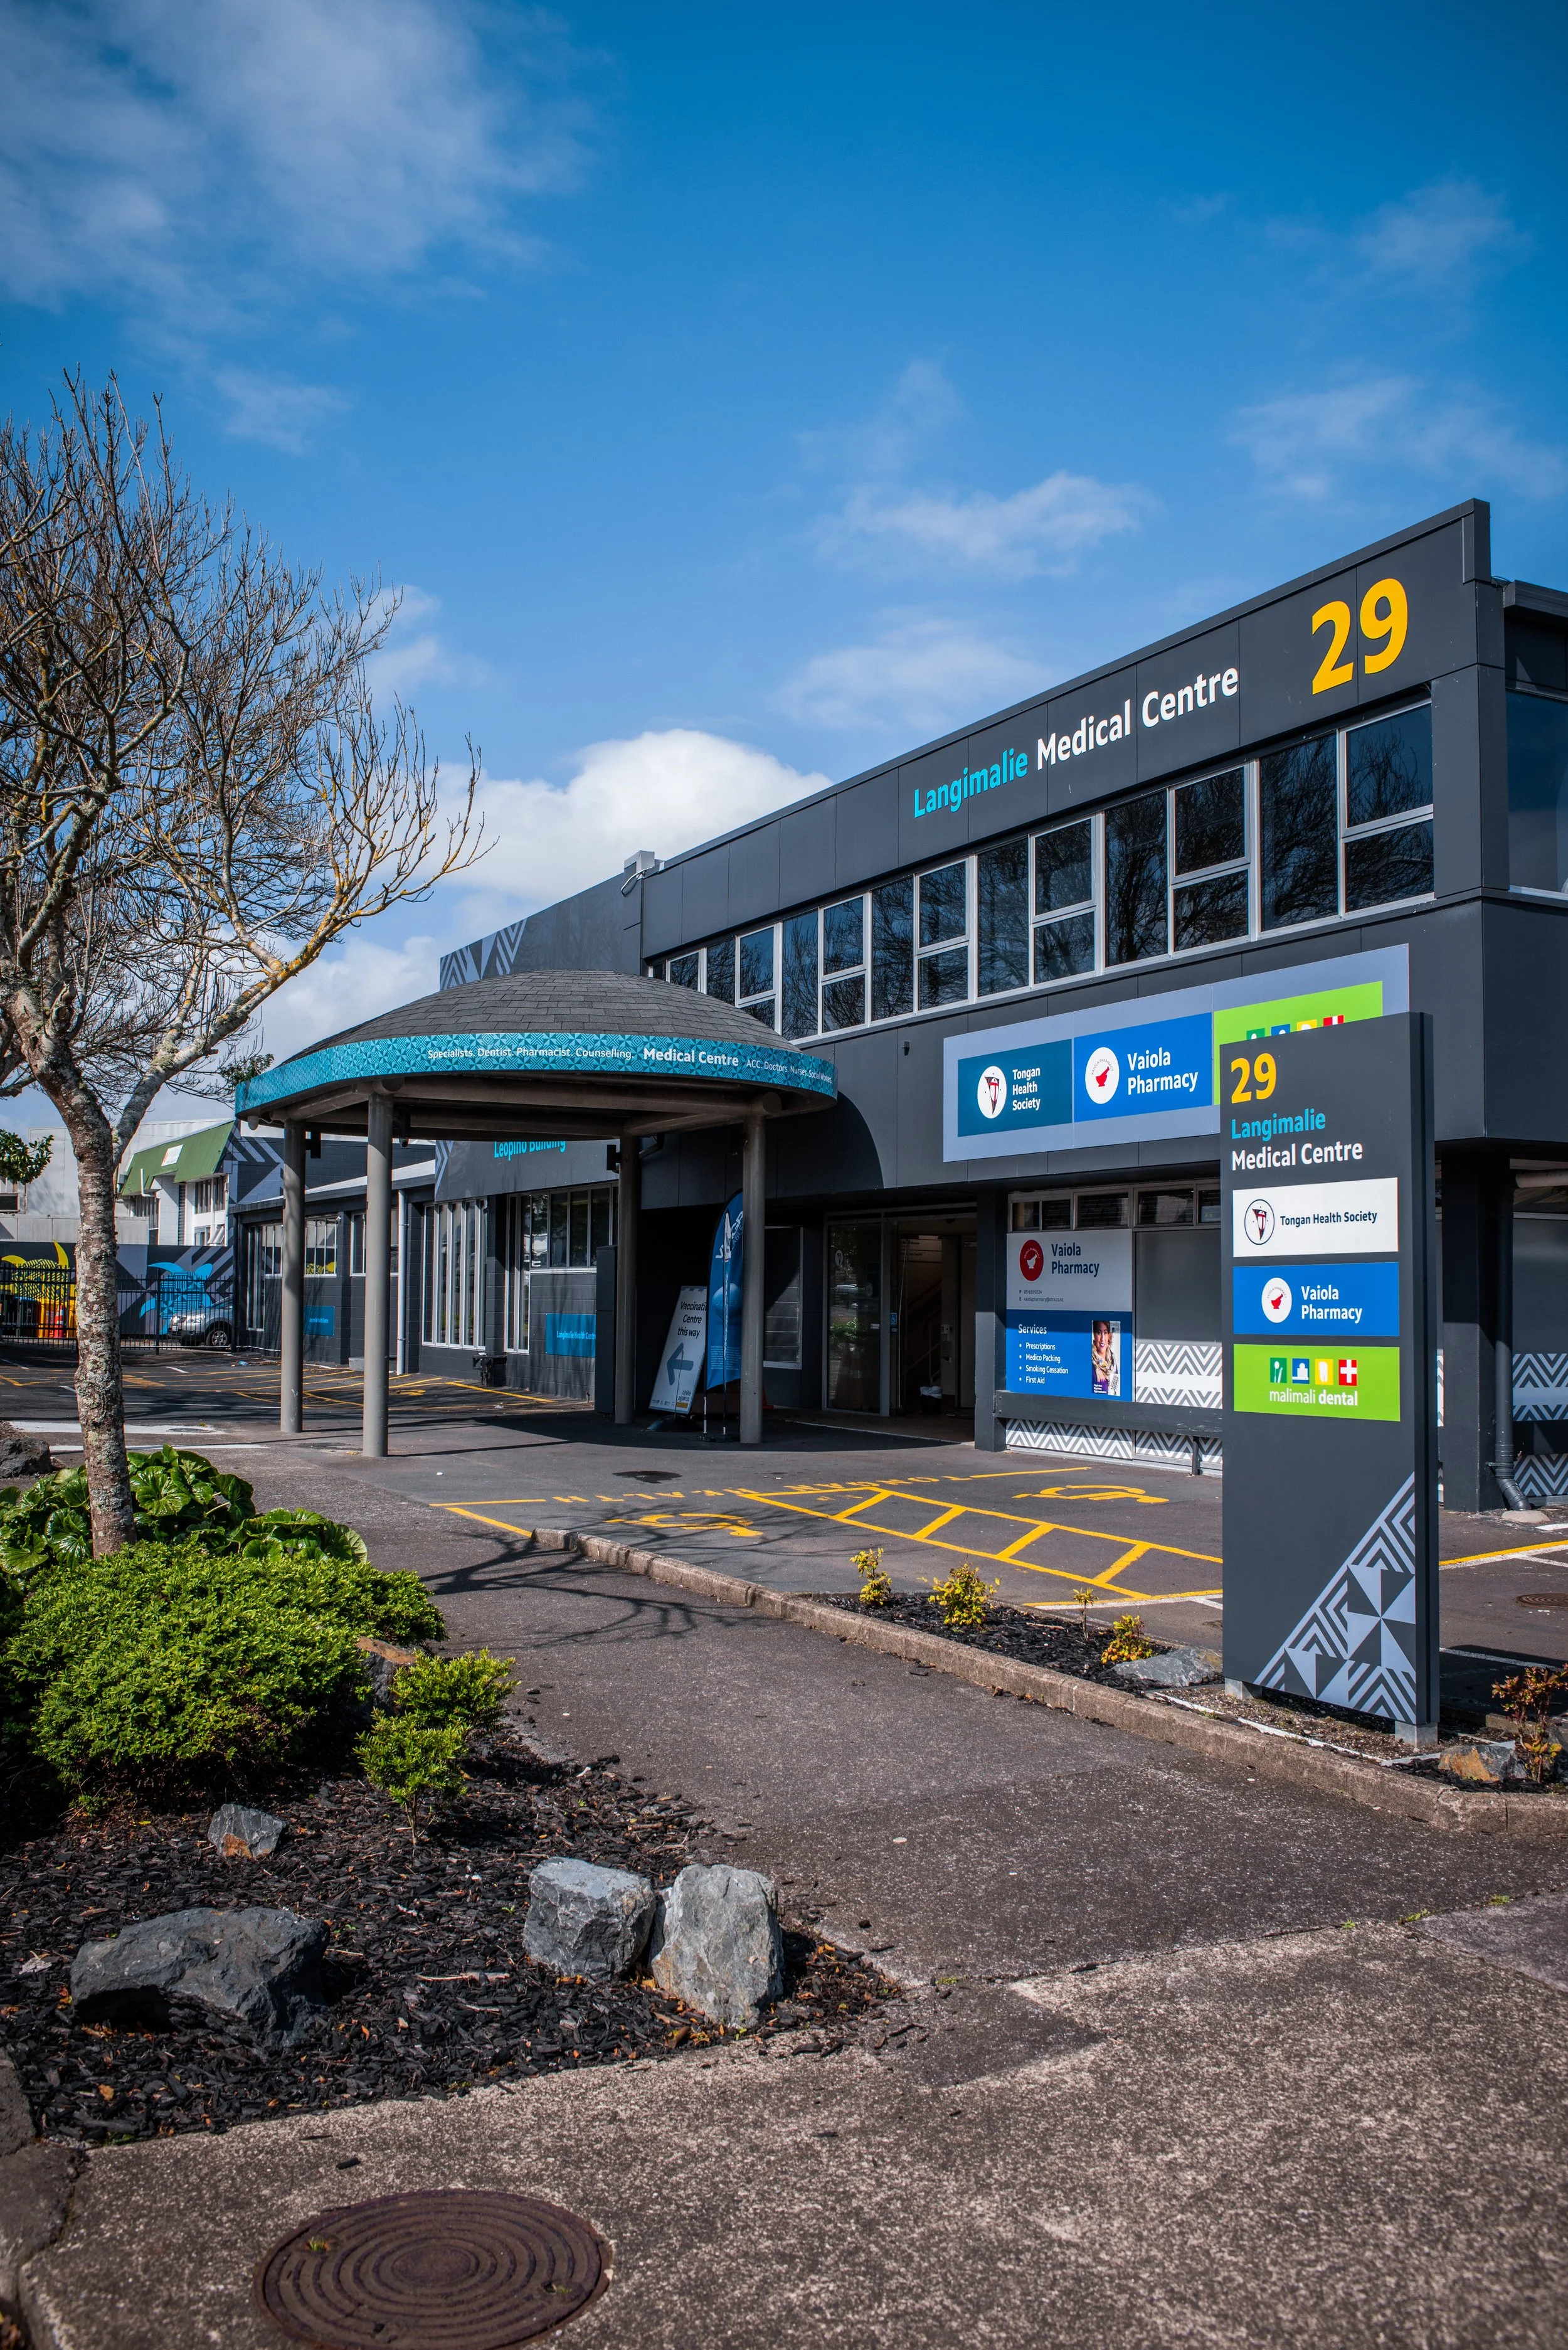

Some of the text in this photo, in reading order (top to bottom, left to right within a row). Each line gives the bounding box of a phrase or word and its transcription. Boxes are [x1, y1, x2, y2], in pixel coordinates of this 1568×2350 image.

[1311, 578, 1409, 695] 29
[914, 667, 1239, 819] Langimalie Medical Centre
[428, 1048, 634, 1060] Specialists. Dentist. Pharmacist. Counselling.
[644, 1048, 739, 1066] Medical Centre
[1127, 1047, 1171, 1071] Vaiola
[764, 1061, 789, 1073] Doctors.
[1012, 1066, 1041, 1082] Tongan
[1128, 1069, 1199, 1096] Pharmacy
[1231, 1053, 1277, 1104] 29
[1012, 1081, 1038, 1095] Health
[1012, 1096, 1041, 1111] Society
[1231, 1108, 1325, 1142] Langimalie
[1232, 1140, 1363, 1171] Medical Centre
[1280, 1210, 1377, 1228] Tongan Health Society
[1051, 1242, 1081, 1257] Vaiola
[1051, 1260, 1099, 1278] Pharmacy
[1301, 1285, 1339, 1300] Vaiola
[681, 1301, 707, 1311] Vaccinati
[1301, 1305, 1362, 1323] Pharmacy
[682, 1314, 702, 1324] Centre
[677, 1327, 700, 1339] this way
[1018, 1324, 1047, 1334] Services
[1025, 1342, 1056, 1351] Prescriptions
[1042, 1354, 1061, 1364] Packing
[1025, 1365, 1069, 1374] Smoking Cessation
[1269, 1388, 1359, 1406] malimali dental
[551, 1475, 972, 1503] TONGAN HEALTH
